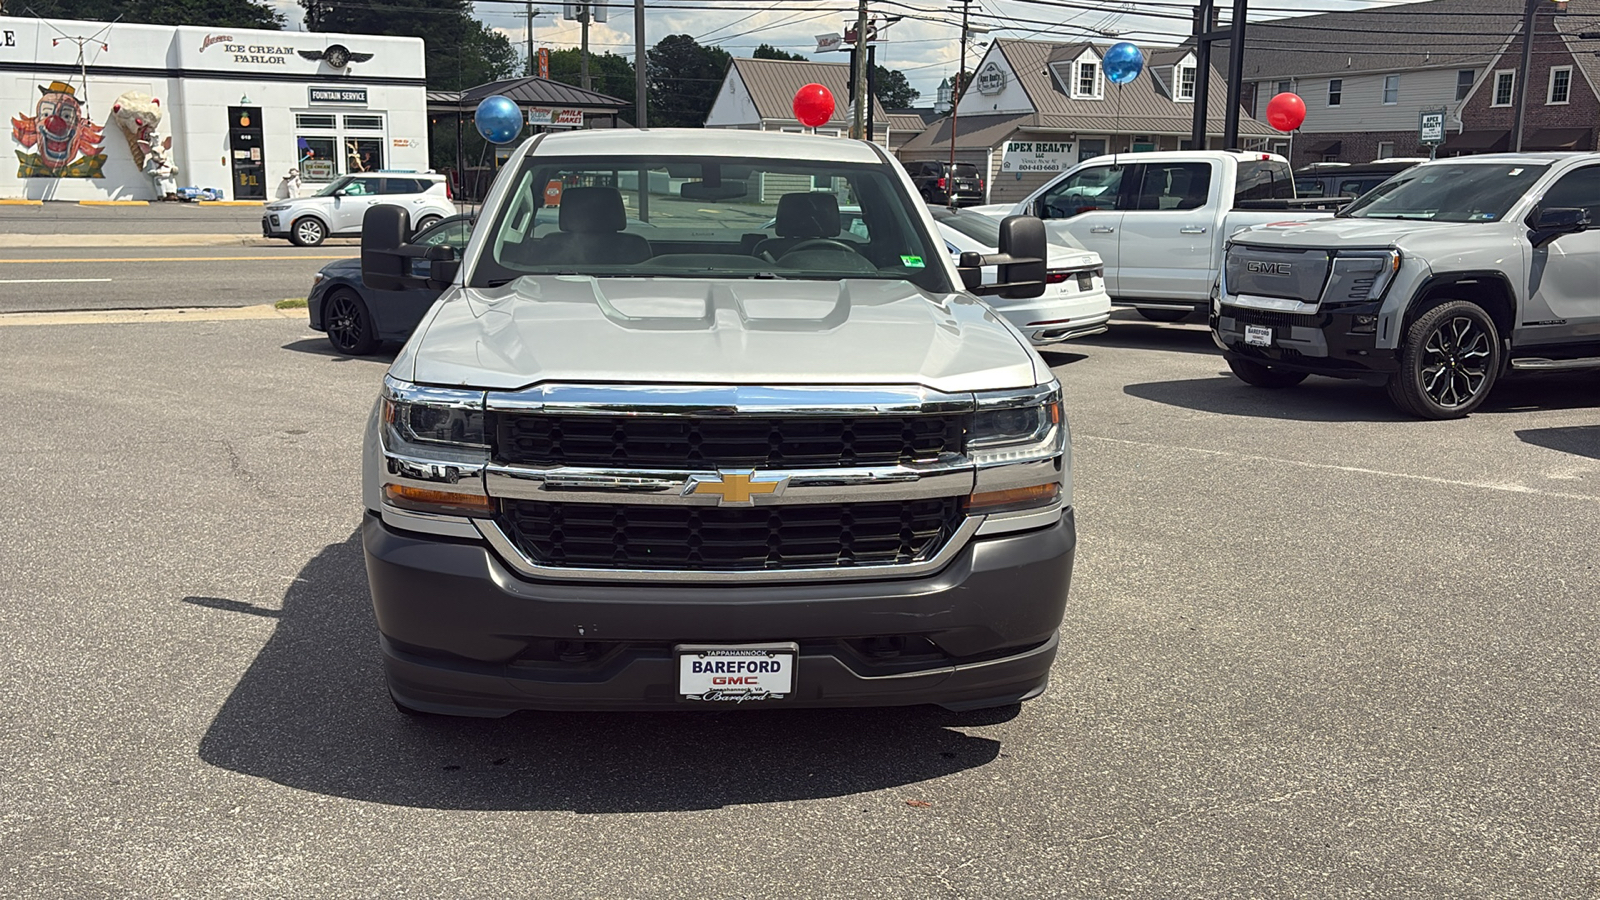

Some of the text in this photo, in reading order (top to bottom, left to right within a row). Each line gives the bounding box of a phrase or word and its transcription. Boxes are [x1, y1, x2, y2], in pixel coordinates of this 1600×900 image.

[0, 30, 16, 47] E
[224, 44, 295, 55] ICE CREAM
[233, 54, 287, 65] PARLOR
[312, 91, 365, 101] FOUNTAIN SERVICE
[560, 109, 583, 117] MILK
[1007, 142, 1073, 153] APEX REALTY
[1247, 260, 1291, 275] GMC
[692, 660, 781, 674] BAREFORD
[712, 676, 759, 686] GMC
[702, 690, 770, 704] Bareford
